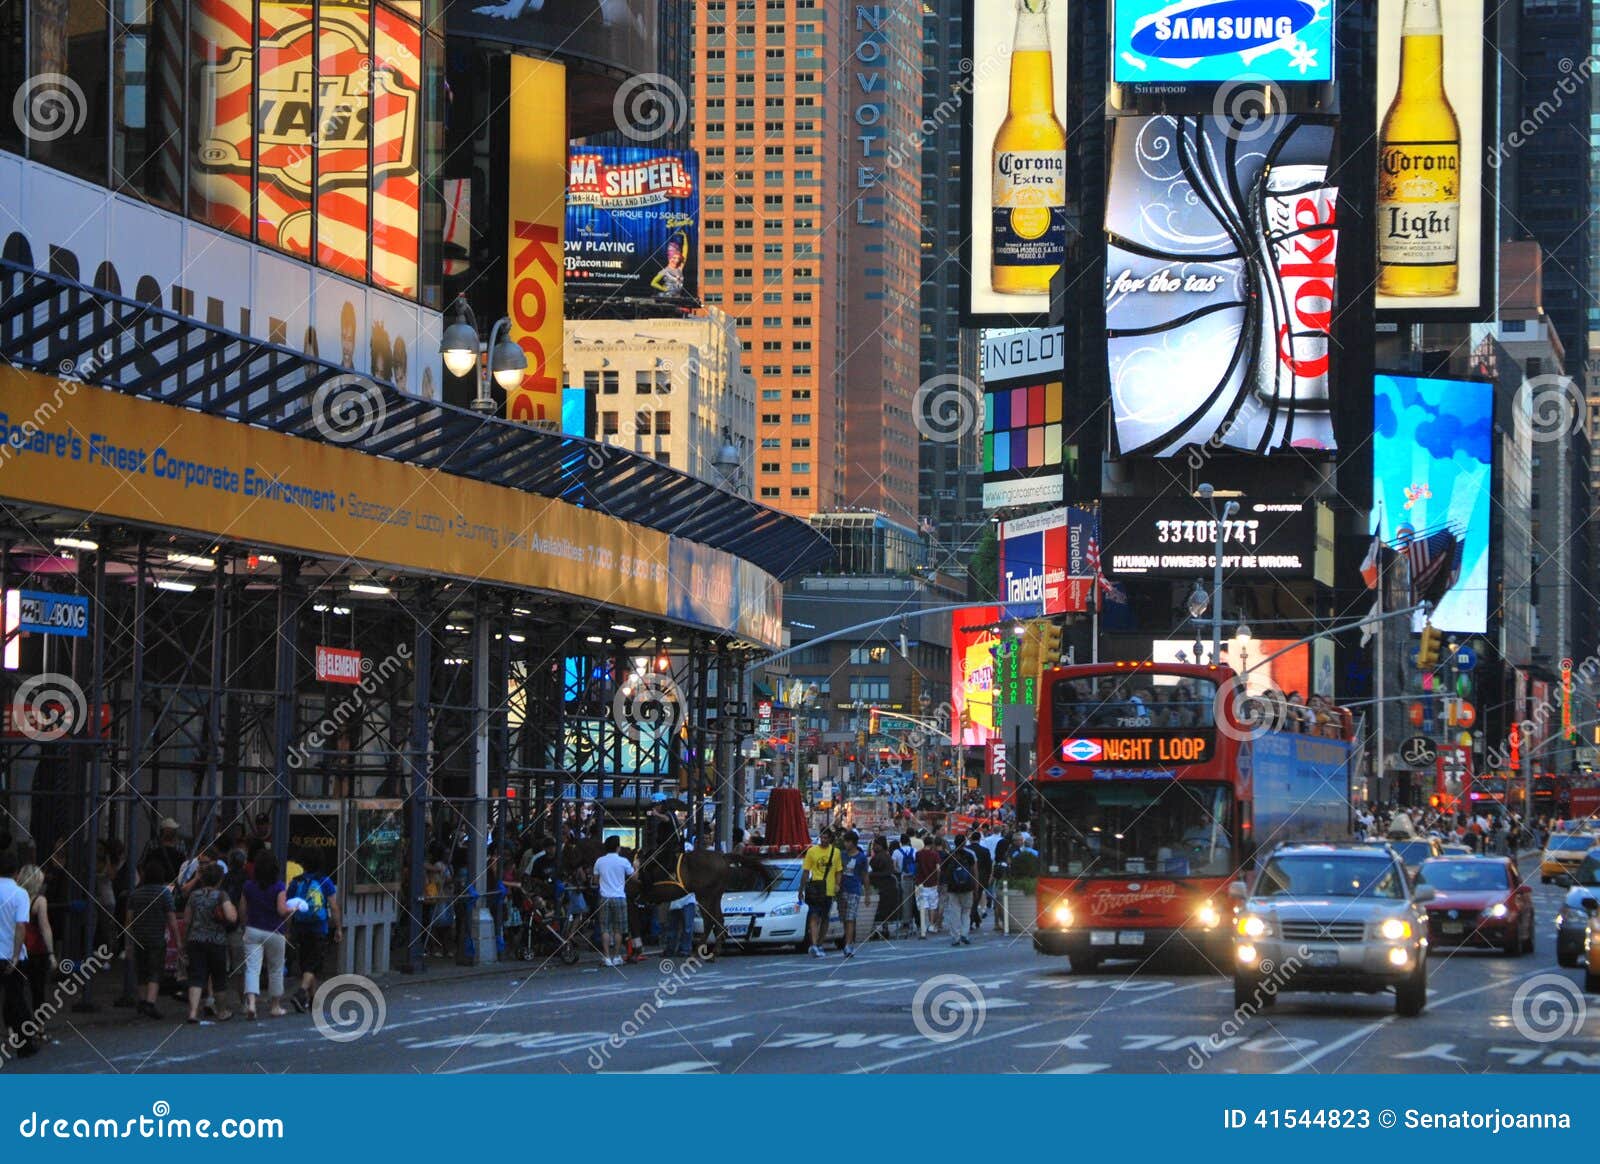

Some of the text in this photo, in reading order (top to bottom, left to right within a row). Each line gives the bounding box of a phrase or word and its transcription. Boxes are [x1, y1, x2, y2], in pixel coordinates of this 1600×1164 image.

[1155, 16, 1292, 40] SAMSUNG
[856, 5, 880, 223] NOVOTEL
[999, 153, 1063, 174] Corona
[1384, 150, 1456, 175] Corona
[605, 163, 686, 196] SHPEEL
[1014, 173, 1053, 185] Extra
[612, 210, 643, 219] CIRQUE
[646, 211, 658, 219] DU
[1388, 207, 1451, 239] Light
[586, 242, 635, 252] PLAYING
[565, 257, 601, 270] Beacon
[1107, 269, 1146, 300] for
[1147, 269, 1181, 292] the
[1280, 197, 1337, 379] Coke
[89, 434, 147, 473] Finest
[153, 448, 239, 491] Corporate
[244, 468, 336, 512] Environment
[1268, 504, 1302, 512] HYUNDAI
[1071, 524, 1081, 574] Travelex
[1113, 556, 1302, 568] HYUNDAI OWNERS CN'T BE WRONG.
[1006, 568, 1044, 602] Travelex
[34, 600, 86, 628] BILLABONG
[327, 653, 359, 678] ELEMENT
[1103, 738, 1205, 760] NIGHT LOOP
[1091, 884, 1176, 915] Broadway
